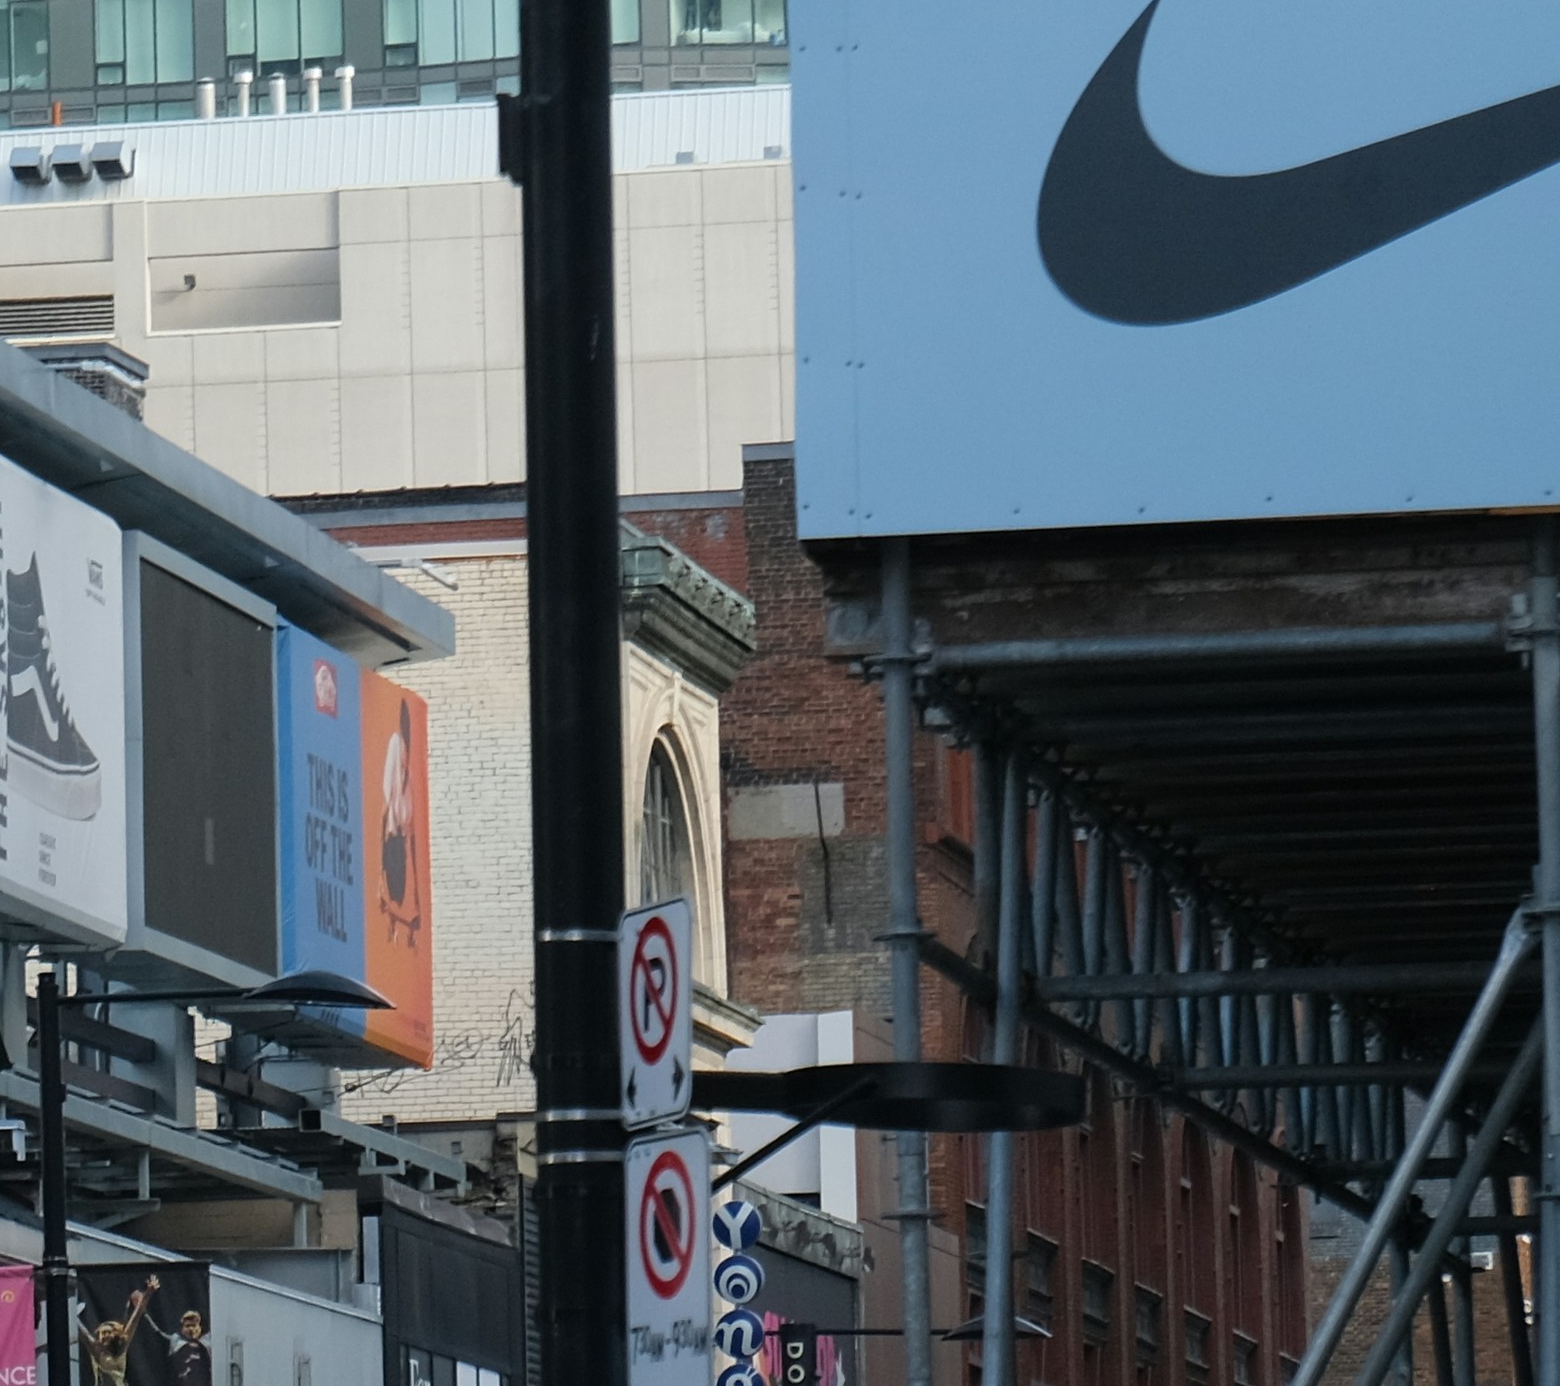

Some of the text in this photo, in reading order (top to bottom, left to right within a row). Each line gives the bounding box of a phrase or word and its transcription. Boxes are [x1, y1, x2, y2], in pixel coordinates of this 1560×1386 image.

[306, 752, 349, 824] THIS IS
[305, 811, 354, 886] OFF THE
[315, 877, 347, 943] WALL
